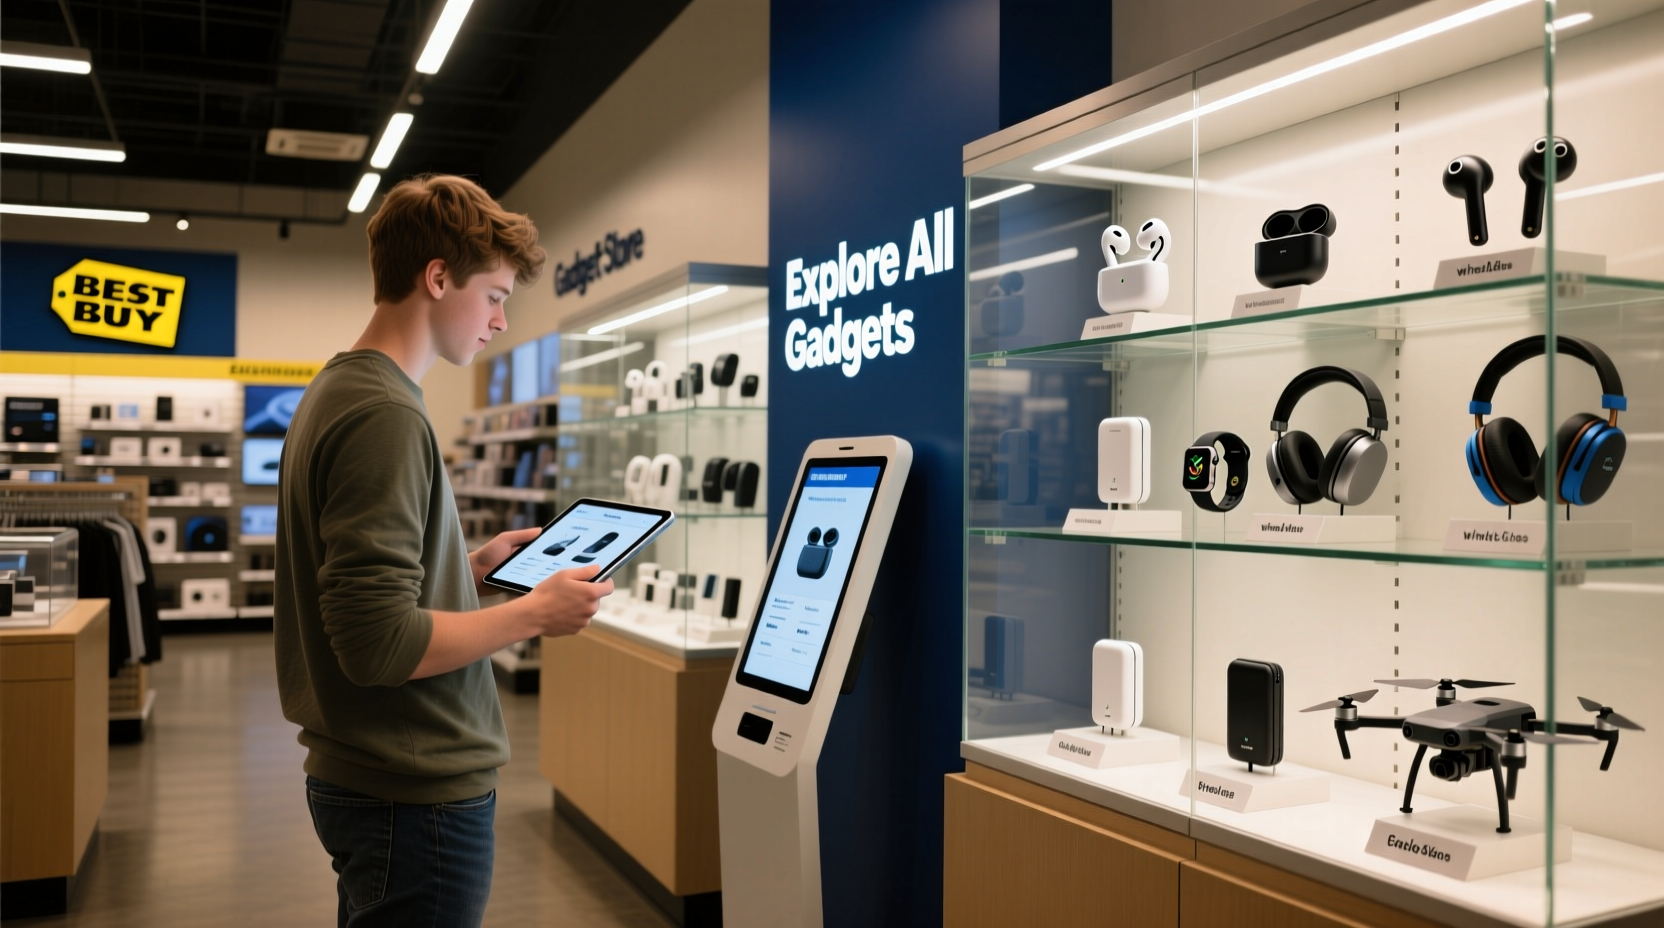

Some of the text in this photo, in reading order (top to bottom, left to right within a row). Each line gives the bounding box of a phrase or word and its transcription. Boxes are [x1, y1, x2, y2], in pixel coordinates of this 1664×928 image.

[554, 241, 602, 297] Gadget
[786, 206, 955, 317] Explore All
[73, 274, 175, 308] BEST
[73, 300, 164, 332] BUY
[785, 302, 915, 378] Gadgets
